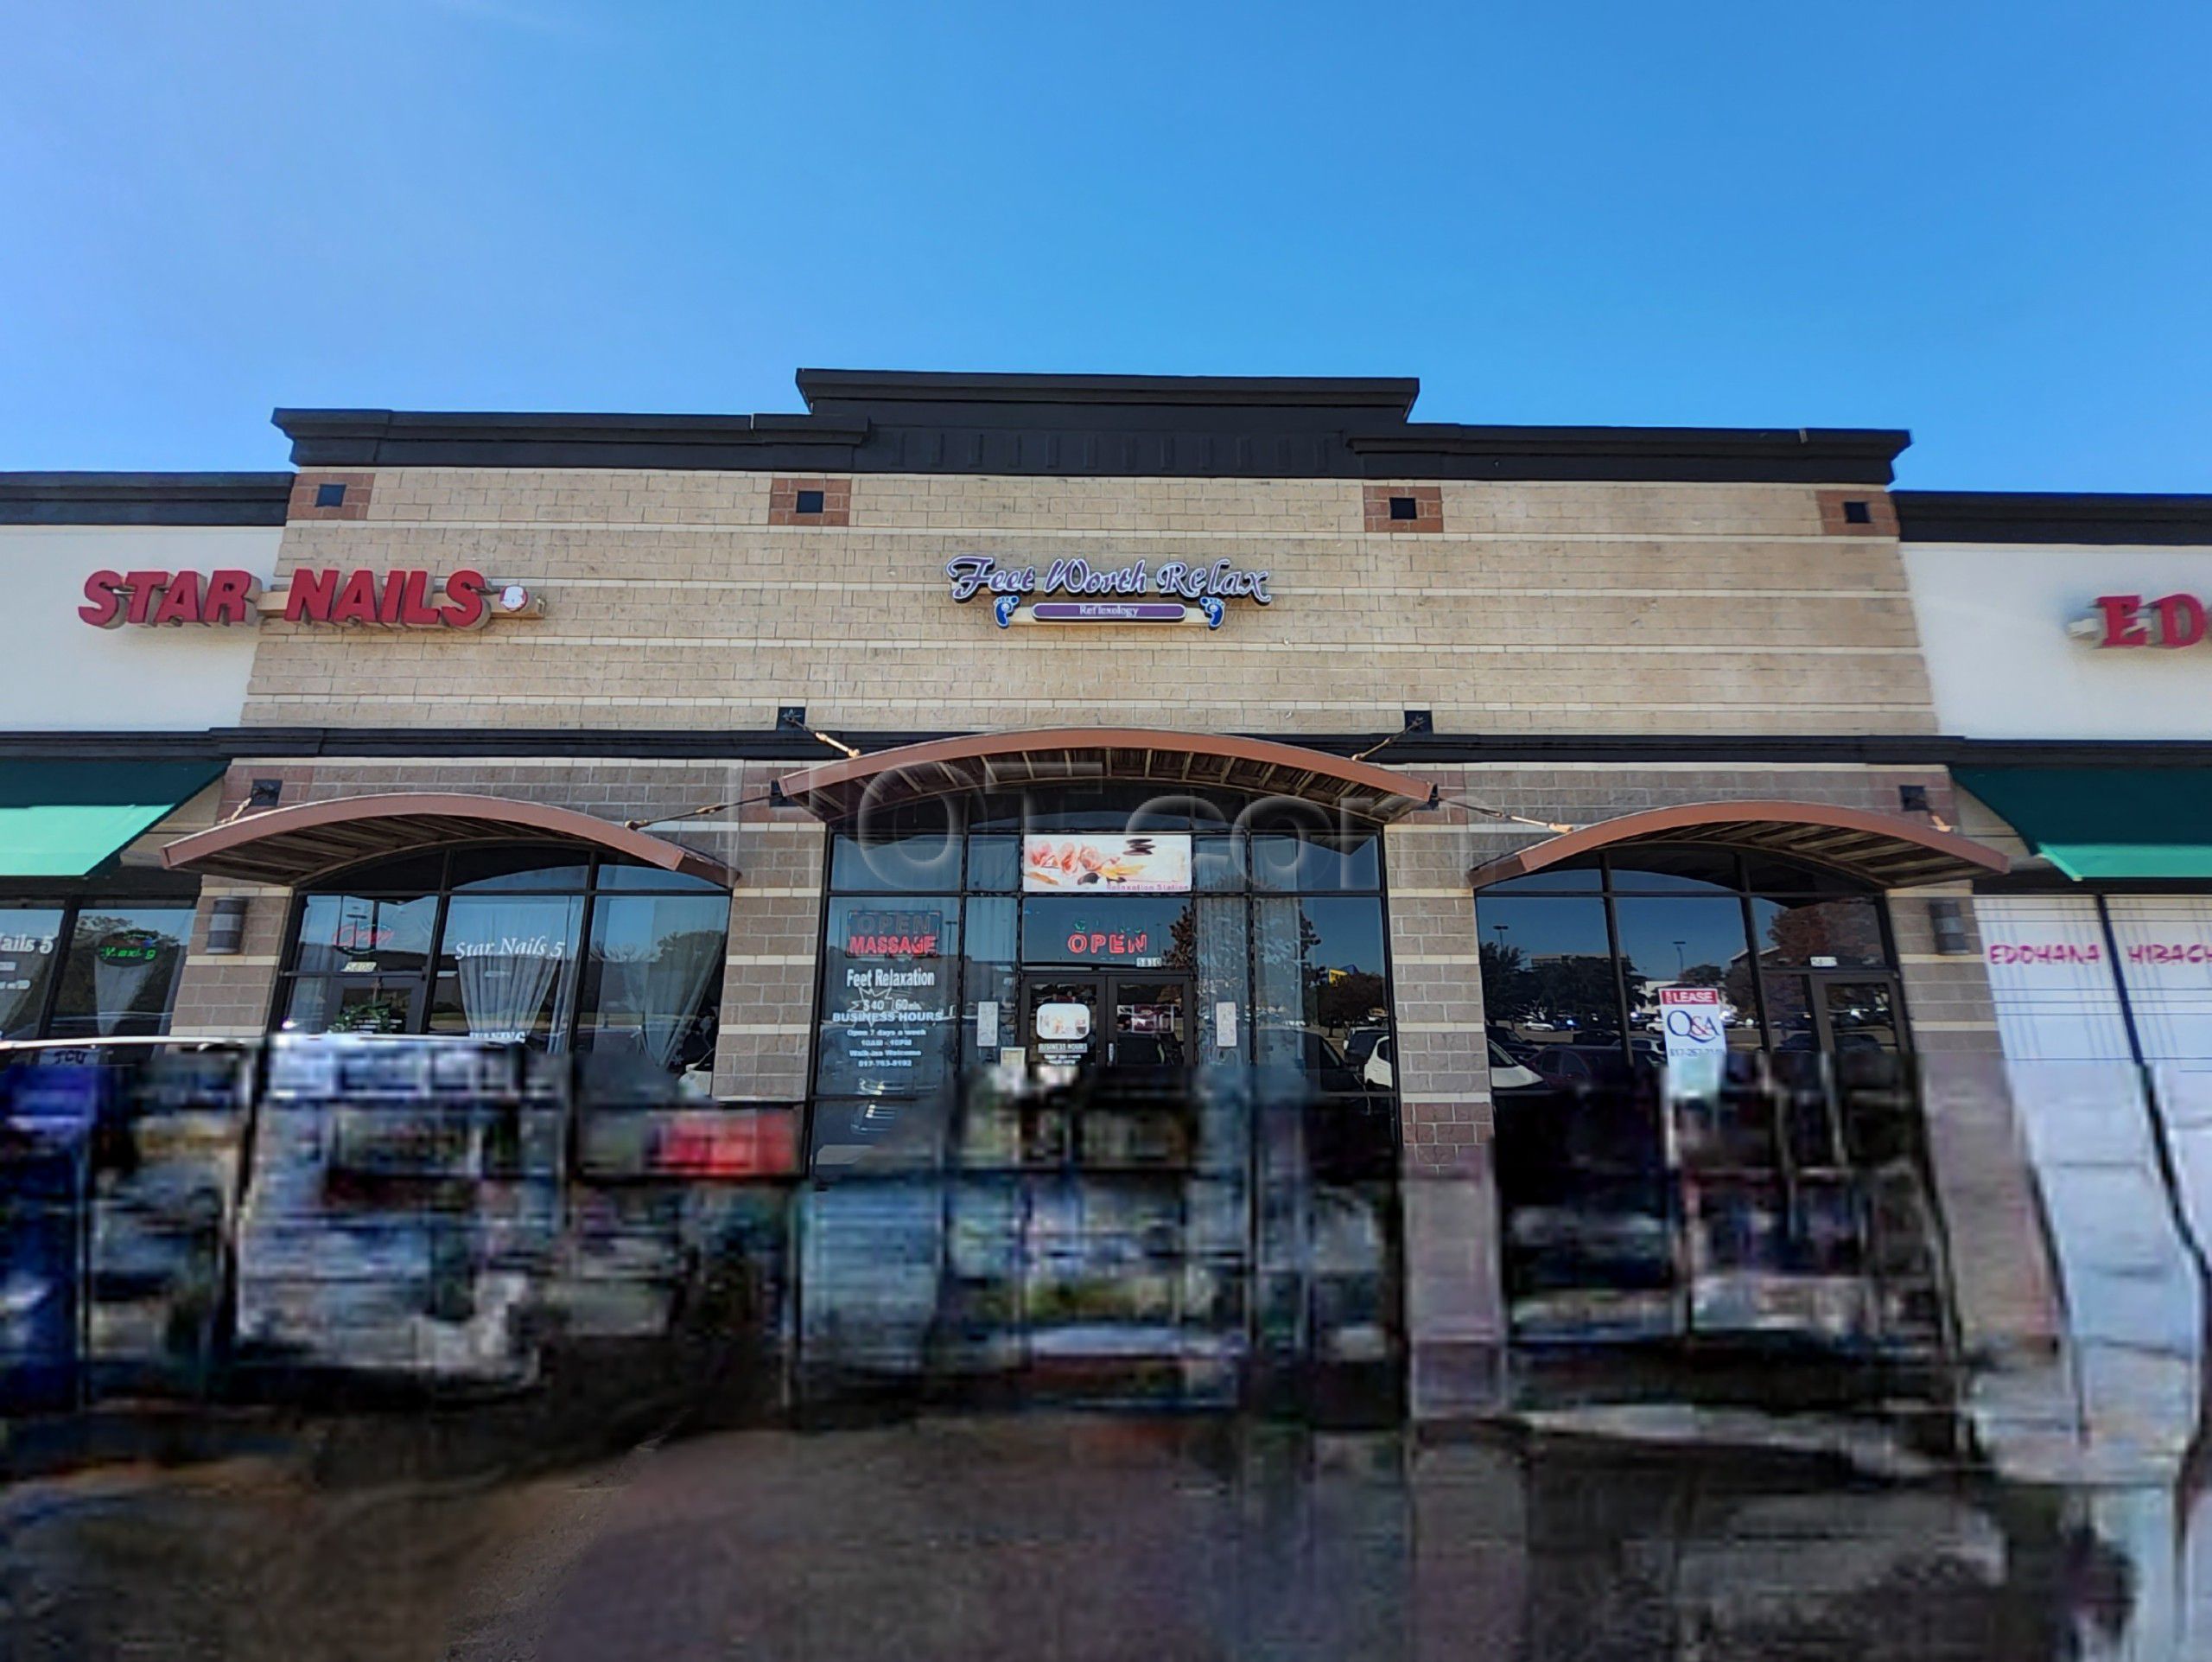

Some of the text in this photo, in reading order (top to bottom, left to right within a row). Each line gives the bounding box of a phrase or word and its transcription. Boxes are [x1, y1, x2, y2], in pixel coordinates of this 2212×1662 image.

[946, 556, 1272, 603] Feet Worth Relax
[78, 568, 487, 628] STAR NAILS
[1079, 604, 1139, 618] Reflexology
[857, 915, 931, 934] OPEN
[0, 933, 54, 954] ails 5
[454, 935, 566, 960] Star Nails 5
[849, 936, 937, 954] MASSAGE
[1067, 933, 1147, 955] OPEN
[1989, 944, 2101, 965] EDOHANA
[847, 966, 935, 987] Feet Relaxation
[1673, 991, 1713, 1003] LEASE
[832, 1011, 944, 1022] BUSINESS HOURS
[1667, 1009, 1720, 1043] Q&A
